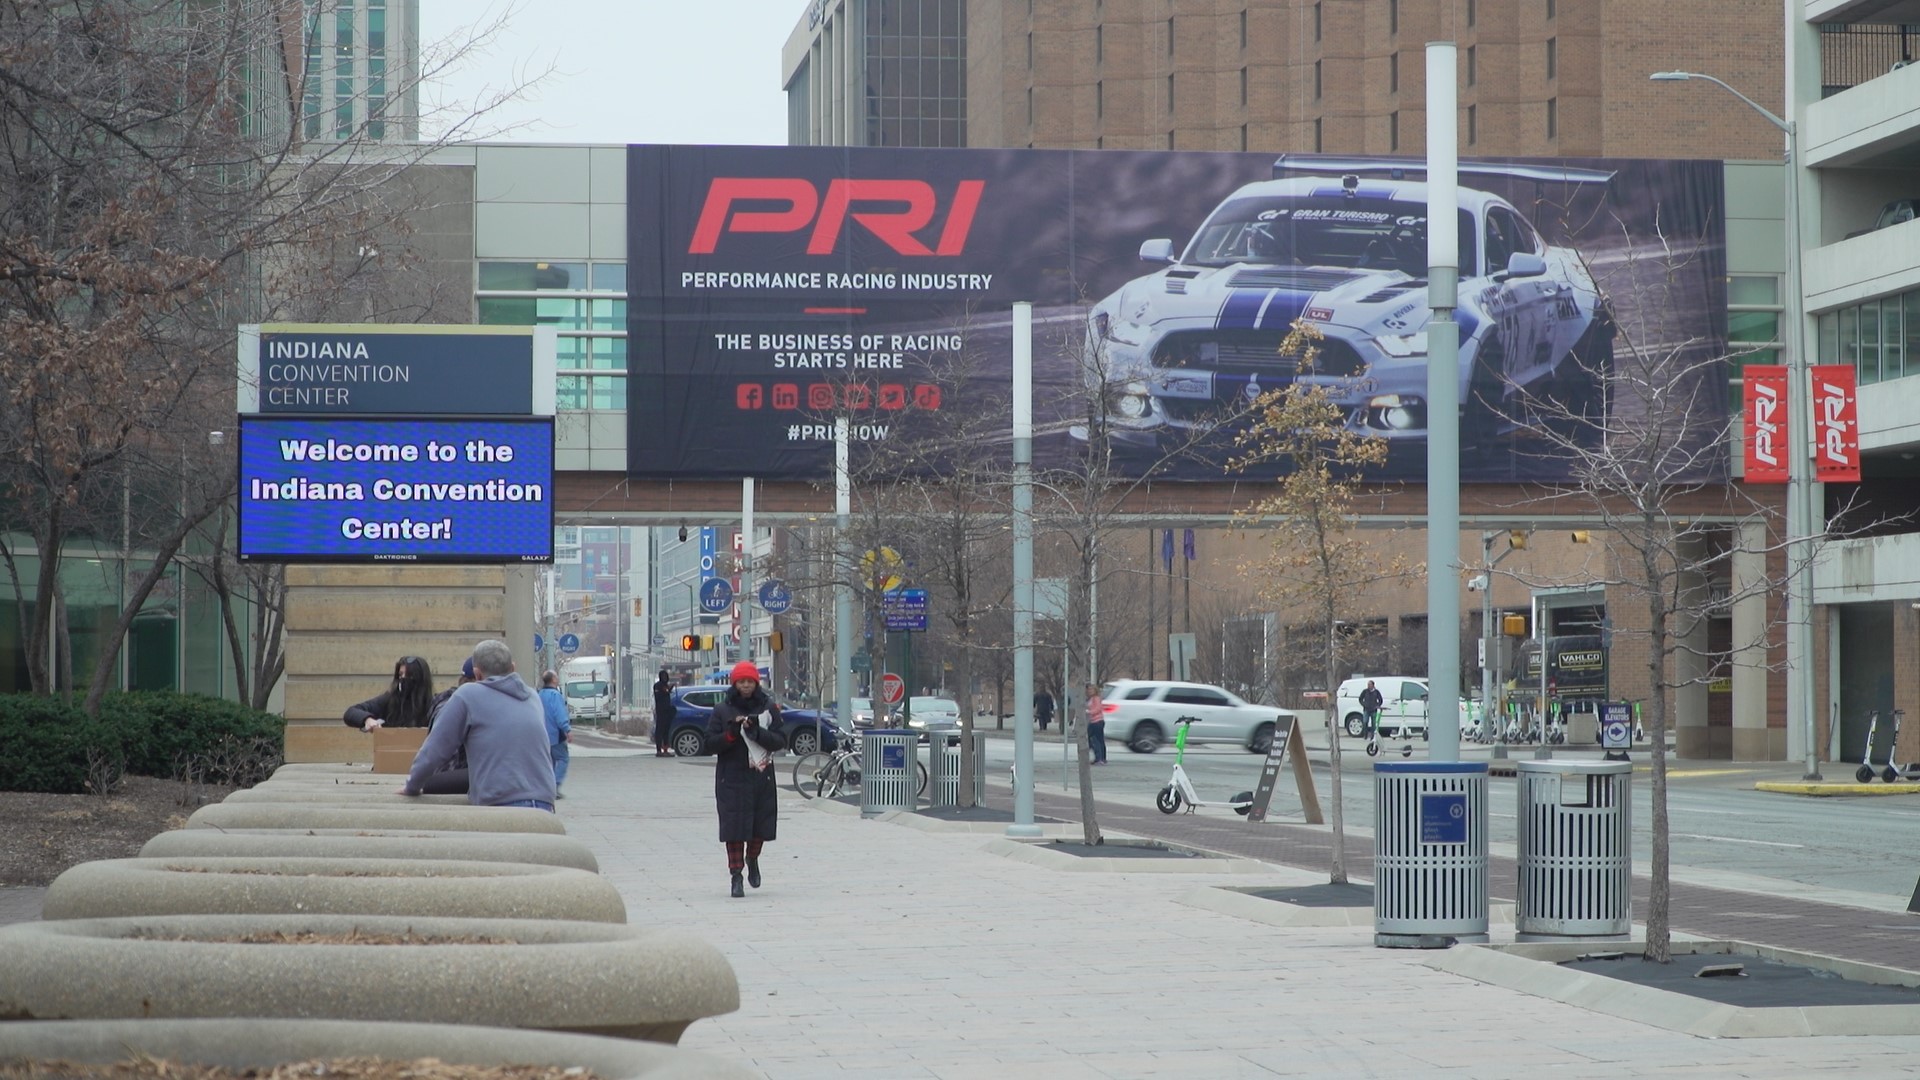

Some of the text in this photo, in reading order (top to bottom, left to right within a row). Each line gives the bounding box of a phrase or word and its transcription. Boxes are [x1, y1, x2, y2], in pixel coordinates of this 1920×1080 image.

[688, 177, 985, 256] PRI
[1292, 209, 1389, 220] GRAN TURISMO
[682, 272, 993, 290] PERFORMANCE RACING INDUSTRY
[1311, 310, 1328, 319] UL
[269, 341, 369, 359] INDIANA
[715, 334, 962, 351] THE BUSINESS OF RACING
[774, 352, 904, 369] STARTS HERE
[268, 364, 409, 383] CONVENTION
[268, 387, 349, 405] CENTER
[1755, 383, 1777, 466] PRI
[1823, 383, 1848, 465] PRI
[280, 439, 513, 462] Welcome to the
[251, 477, 543, 501] Indiana Convention
[341, 517, 452, 540] Center!
[705, 599, 726, 607] LEFT
[764, 600, 787, 608] RIGHT
[1561, 653, 1600, 662] VAHLCO
[1604, 713, 1630, 721] ELEVATORS
